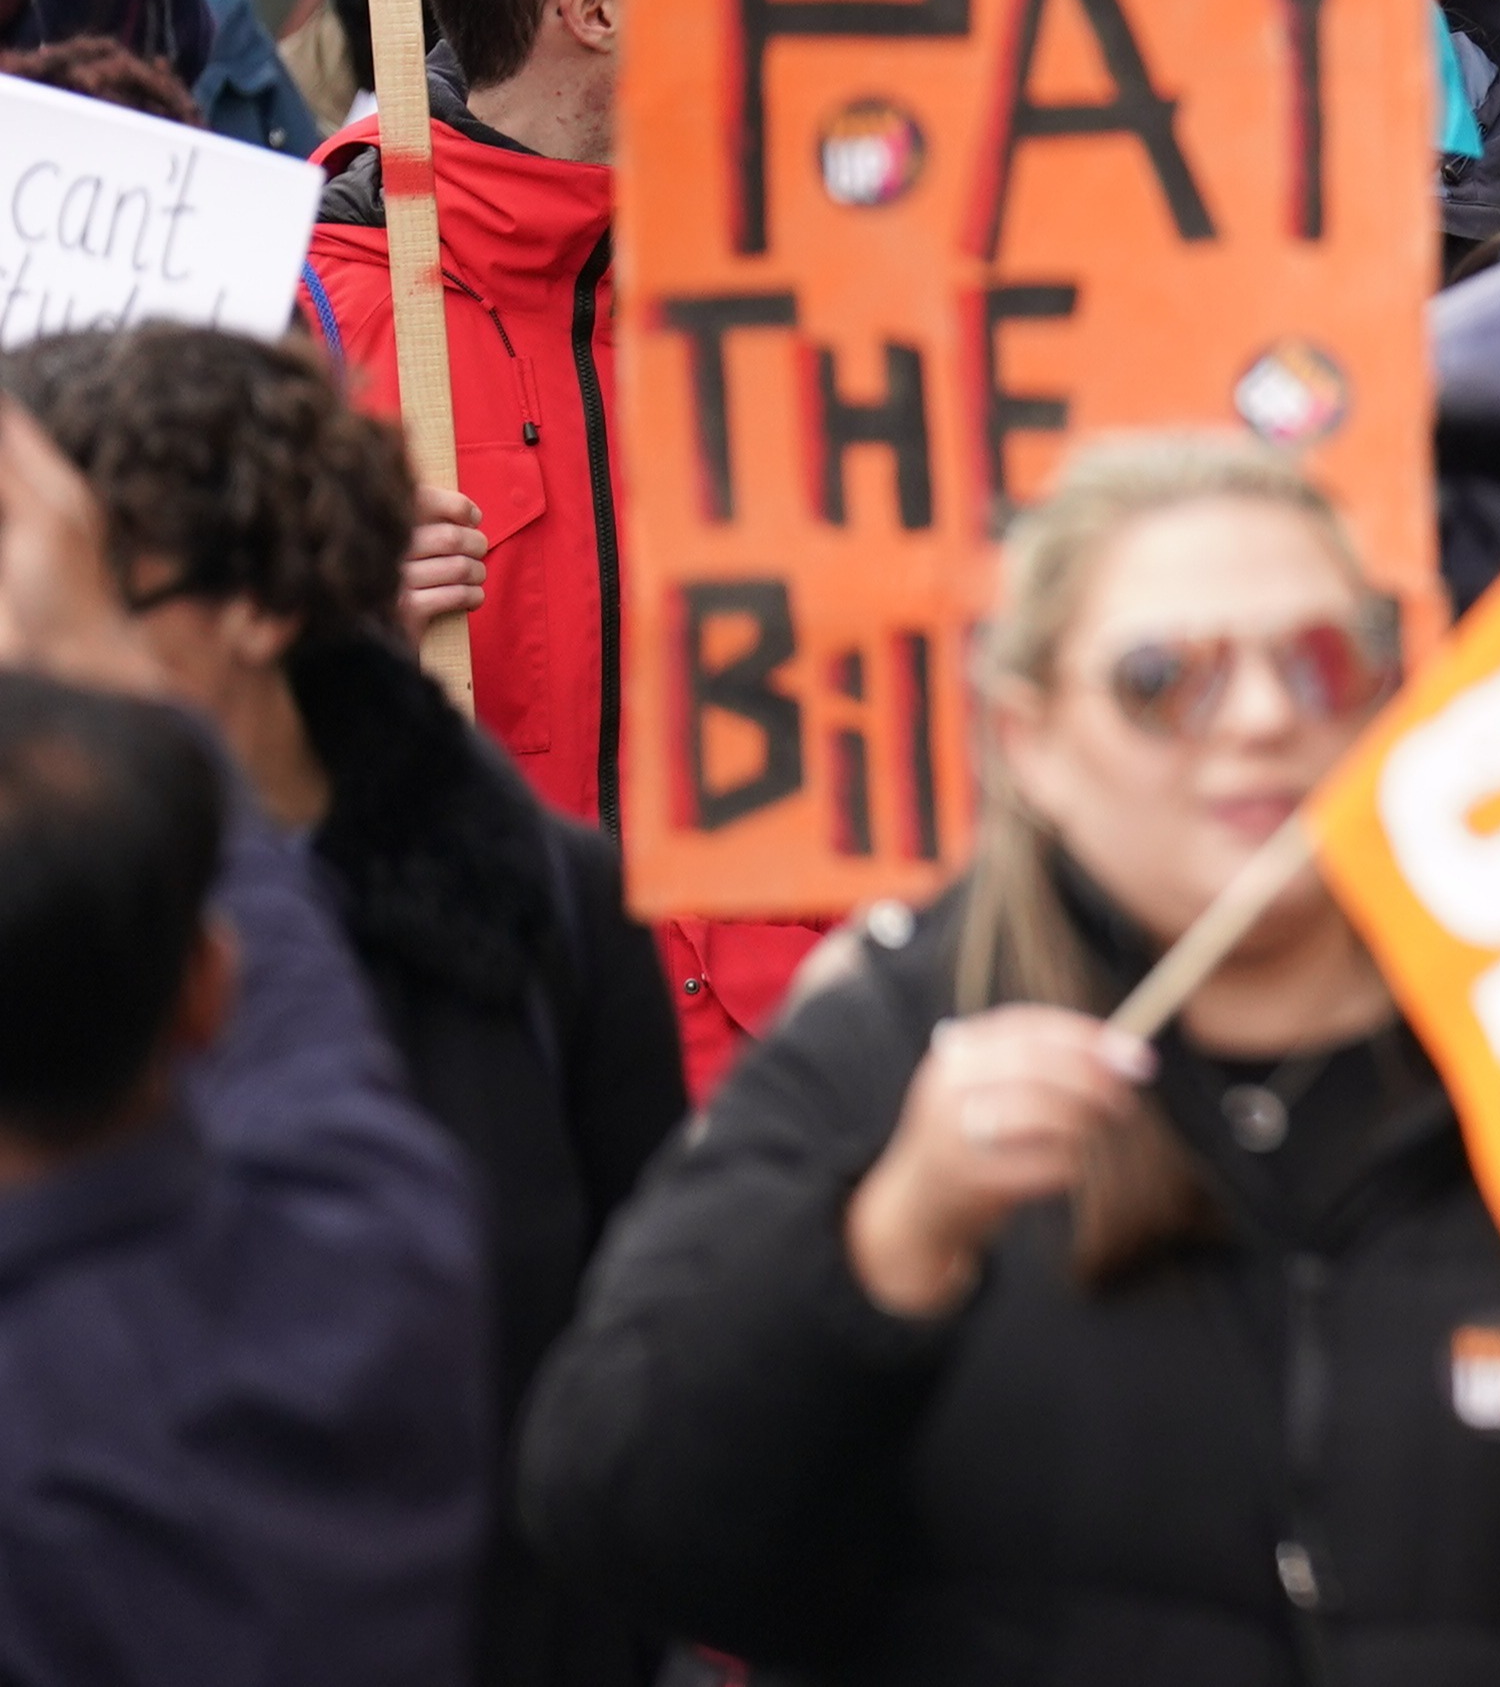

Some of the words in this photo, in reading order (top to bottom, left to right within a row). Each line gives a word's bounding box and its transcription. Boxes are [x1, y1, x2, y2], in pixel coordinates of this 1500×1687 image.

[11, 142, 200, 285] can't
[650, 278, 1080, 548] THE
[664, 572, 945, 867] Bil
